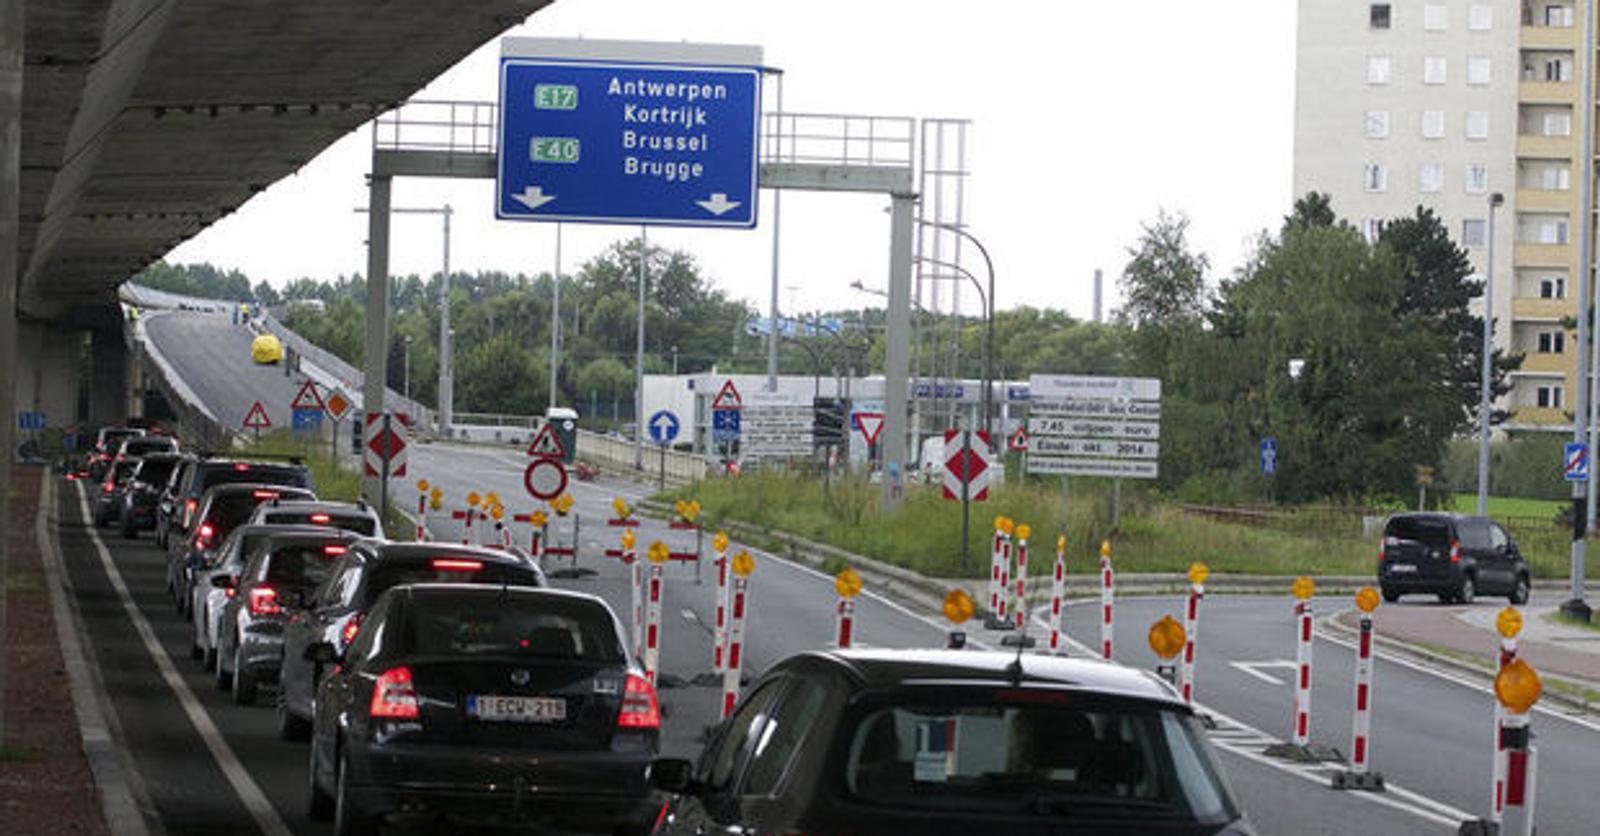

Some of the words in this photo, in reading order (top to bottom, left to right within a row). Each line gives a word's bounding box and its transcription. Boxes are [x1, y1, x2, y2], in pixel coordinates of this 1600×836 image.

[537, 88, 575, 106] E17
[607, 77, 726, 101] Antwerpen
[624, 103, 706, 129] Kortrijk
[533, 140, 577, 159] E40
[624, 130, 707, 151] Brussel
[624, 157, 703, 181] Brugge
